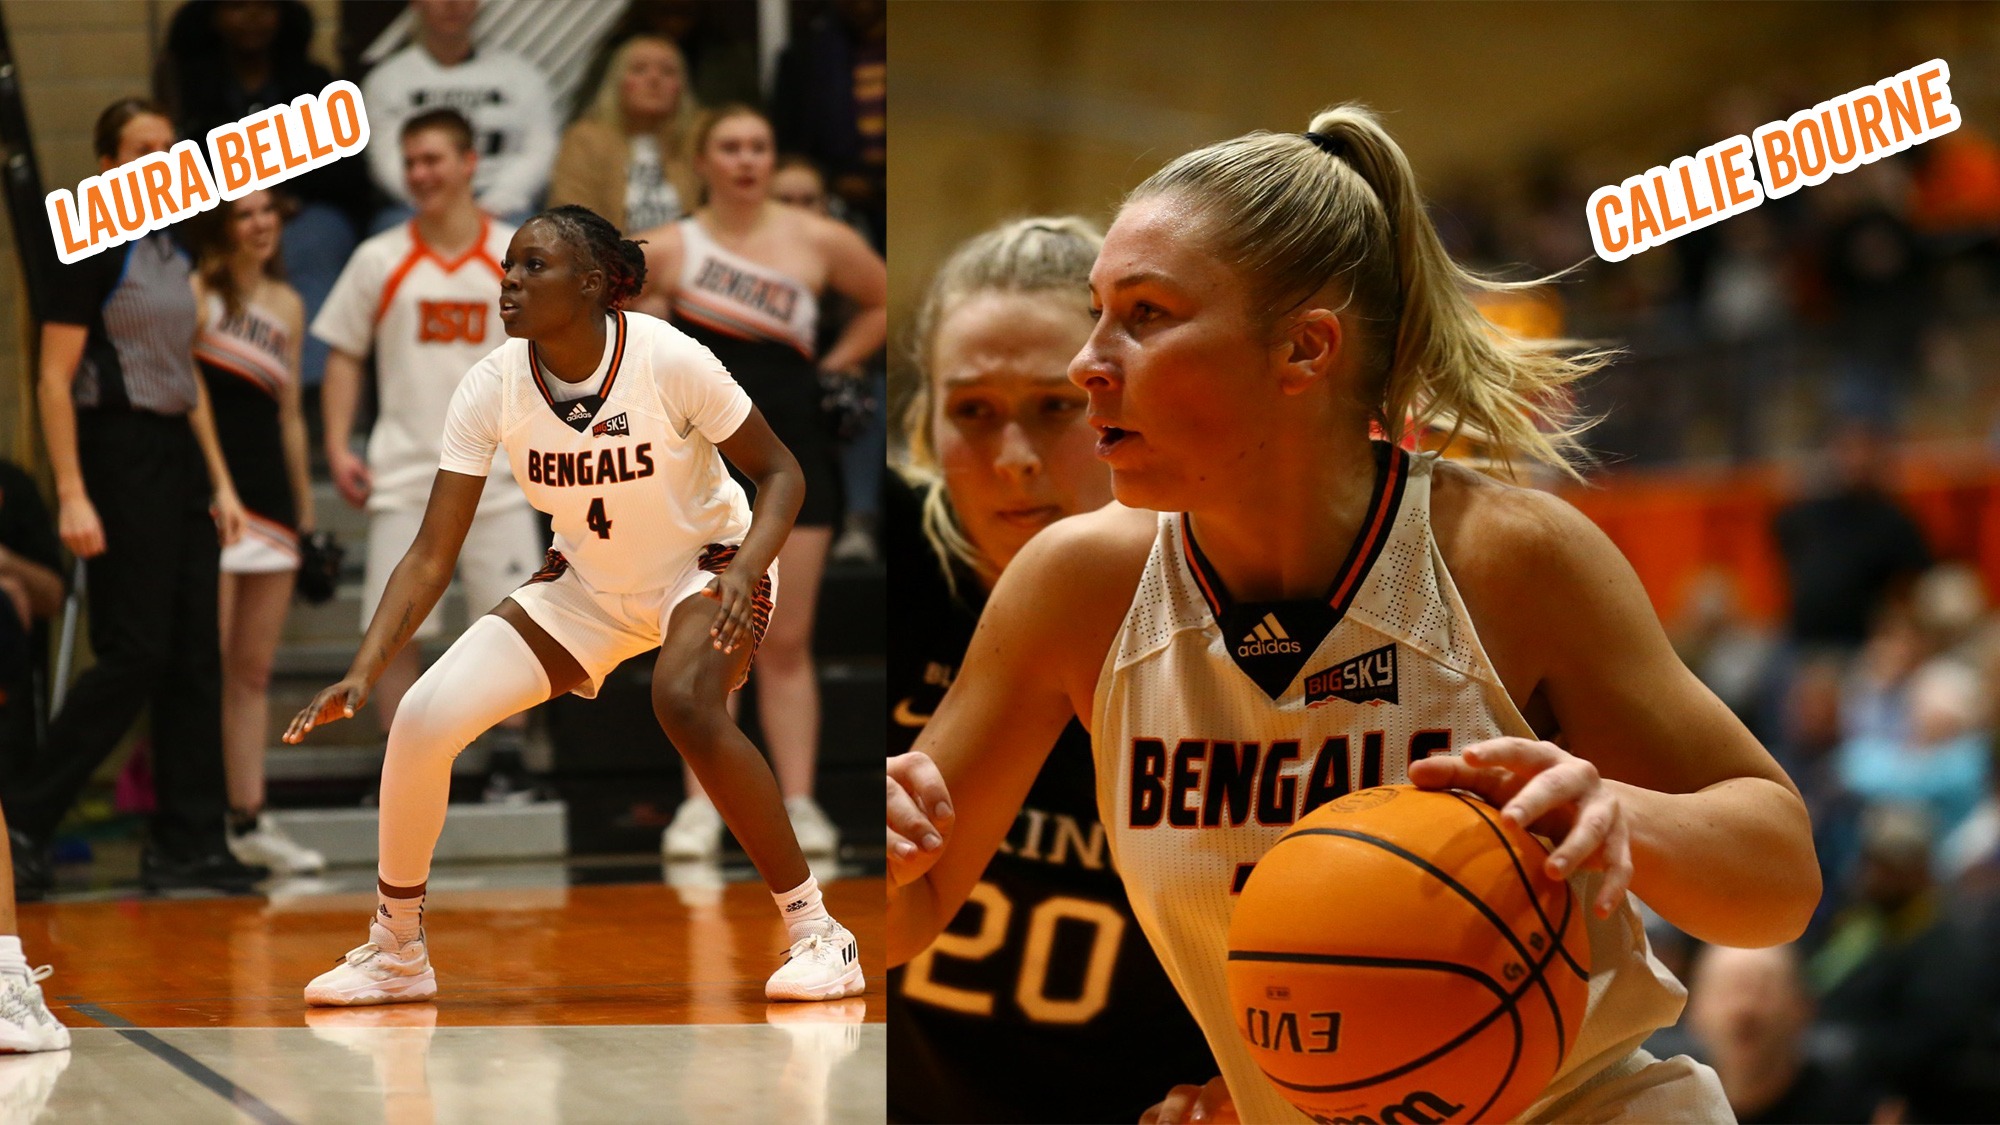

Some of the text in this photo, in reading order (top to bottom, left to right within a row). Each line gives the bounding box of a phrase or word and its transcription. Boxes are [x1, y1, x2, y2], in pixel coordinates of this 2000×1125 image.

[566, 412, 592, 422] adidas
[528, 442, 655, 487] BENGALS
[586, 497, 613, 540] 4
[1238, 639, 1301, 658] adidas
[902, 880, 1126, 1024] 20
